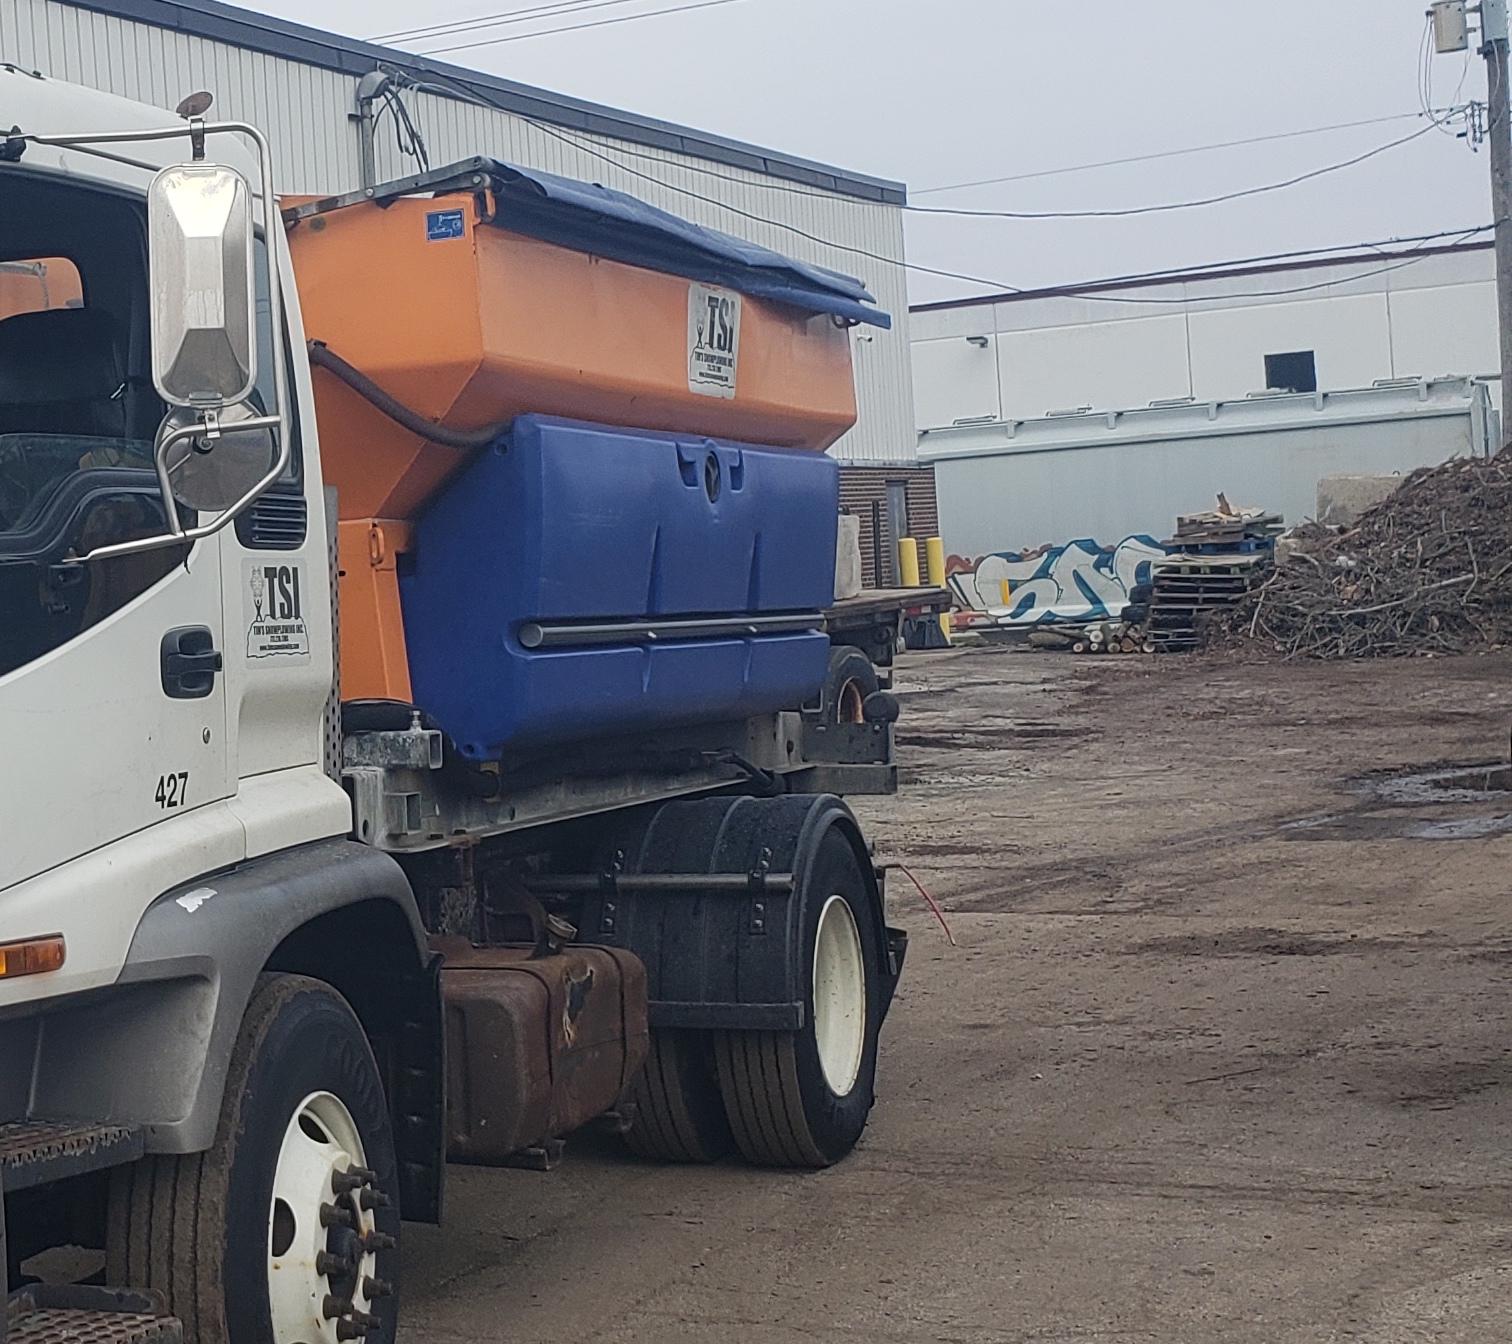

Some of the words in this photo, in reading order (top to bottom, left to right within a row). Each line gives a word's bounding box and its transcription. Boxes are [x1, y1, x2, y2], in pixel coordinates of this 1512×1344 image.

[708, 296, 735, 353] TSI
[264, 566, 300, 620] TSI
[155, 771, 188, 809] 427
